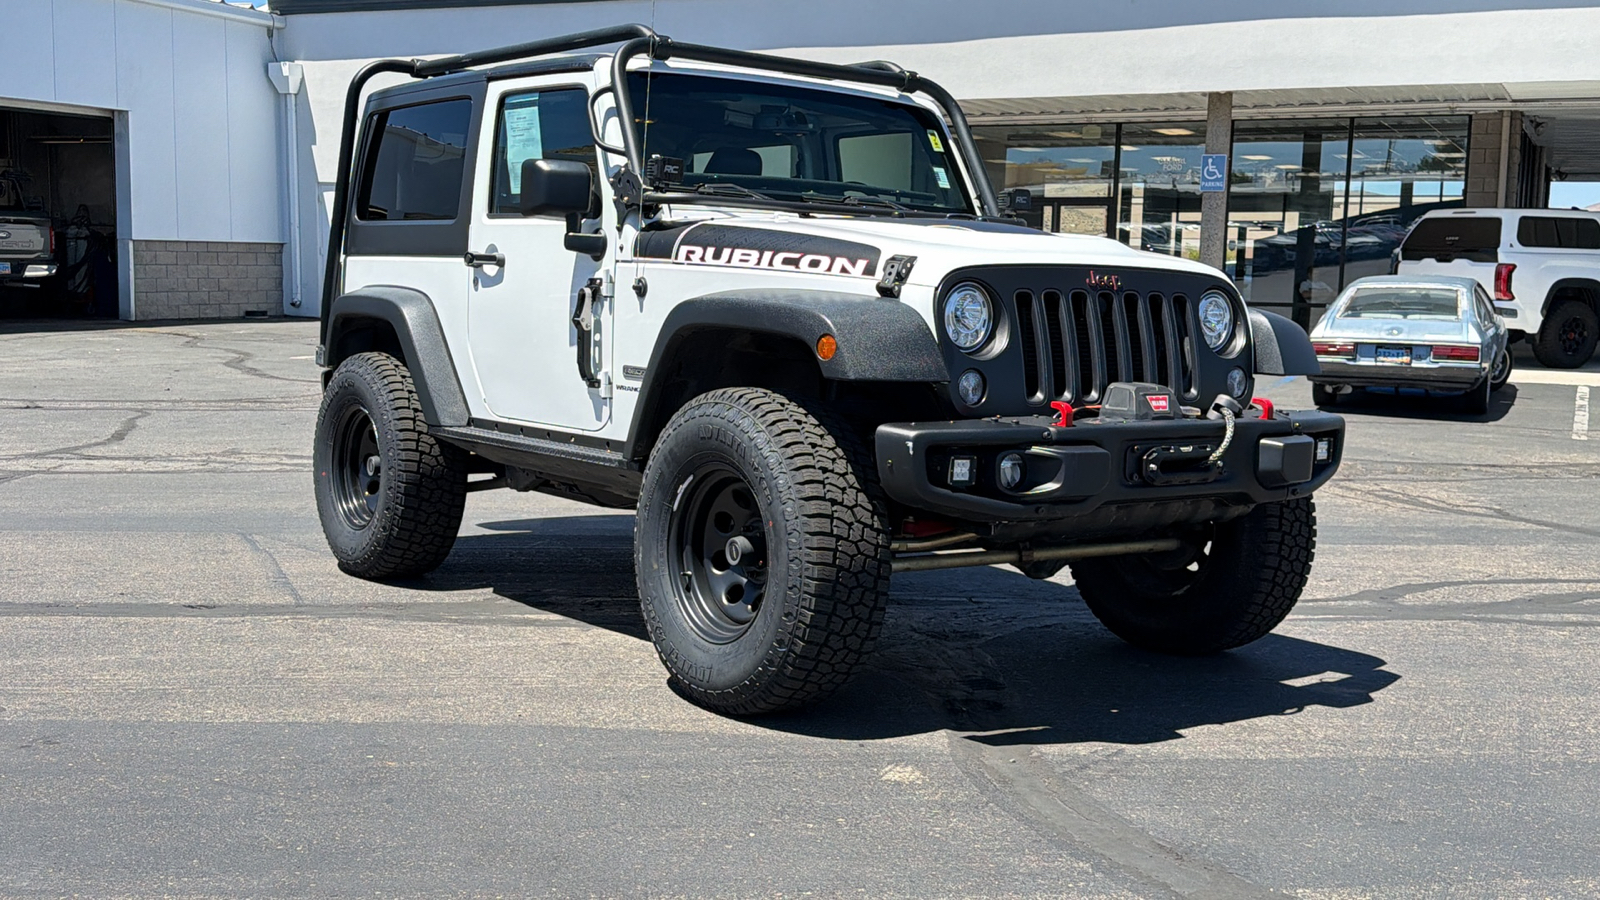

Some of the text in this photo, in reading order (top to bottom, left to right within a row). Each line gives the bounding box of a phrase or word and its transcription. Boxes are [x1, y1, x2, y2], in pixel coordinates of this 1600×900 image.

[663, 164, 680, 174] RC
[1162, 164, 1183, 172] FORD
[1015, 196, 1028, 204] RC
[675, 245, 869, 277] RUBICON
[1086, 270, 1121, 290] Jeep
